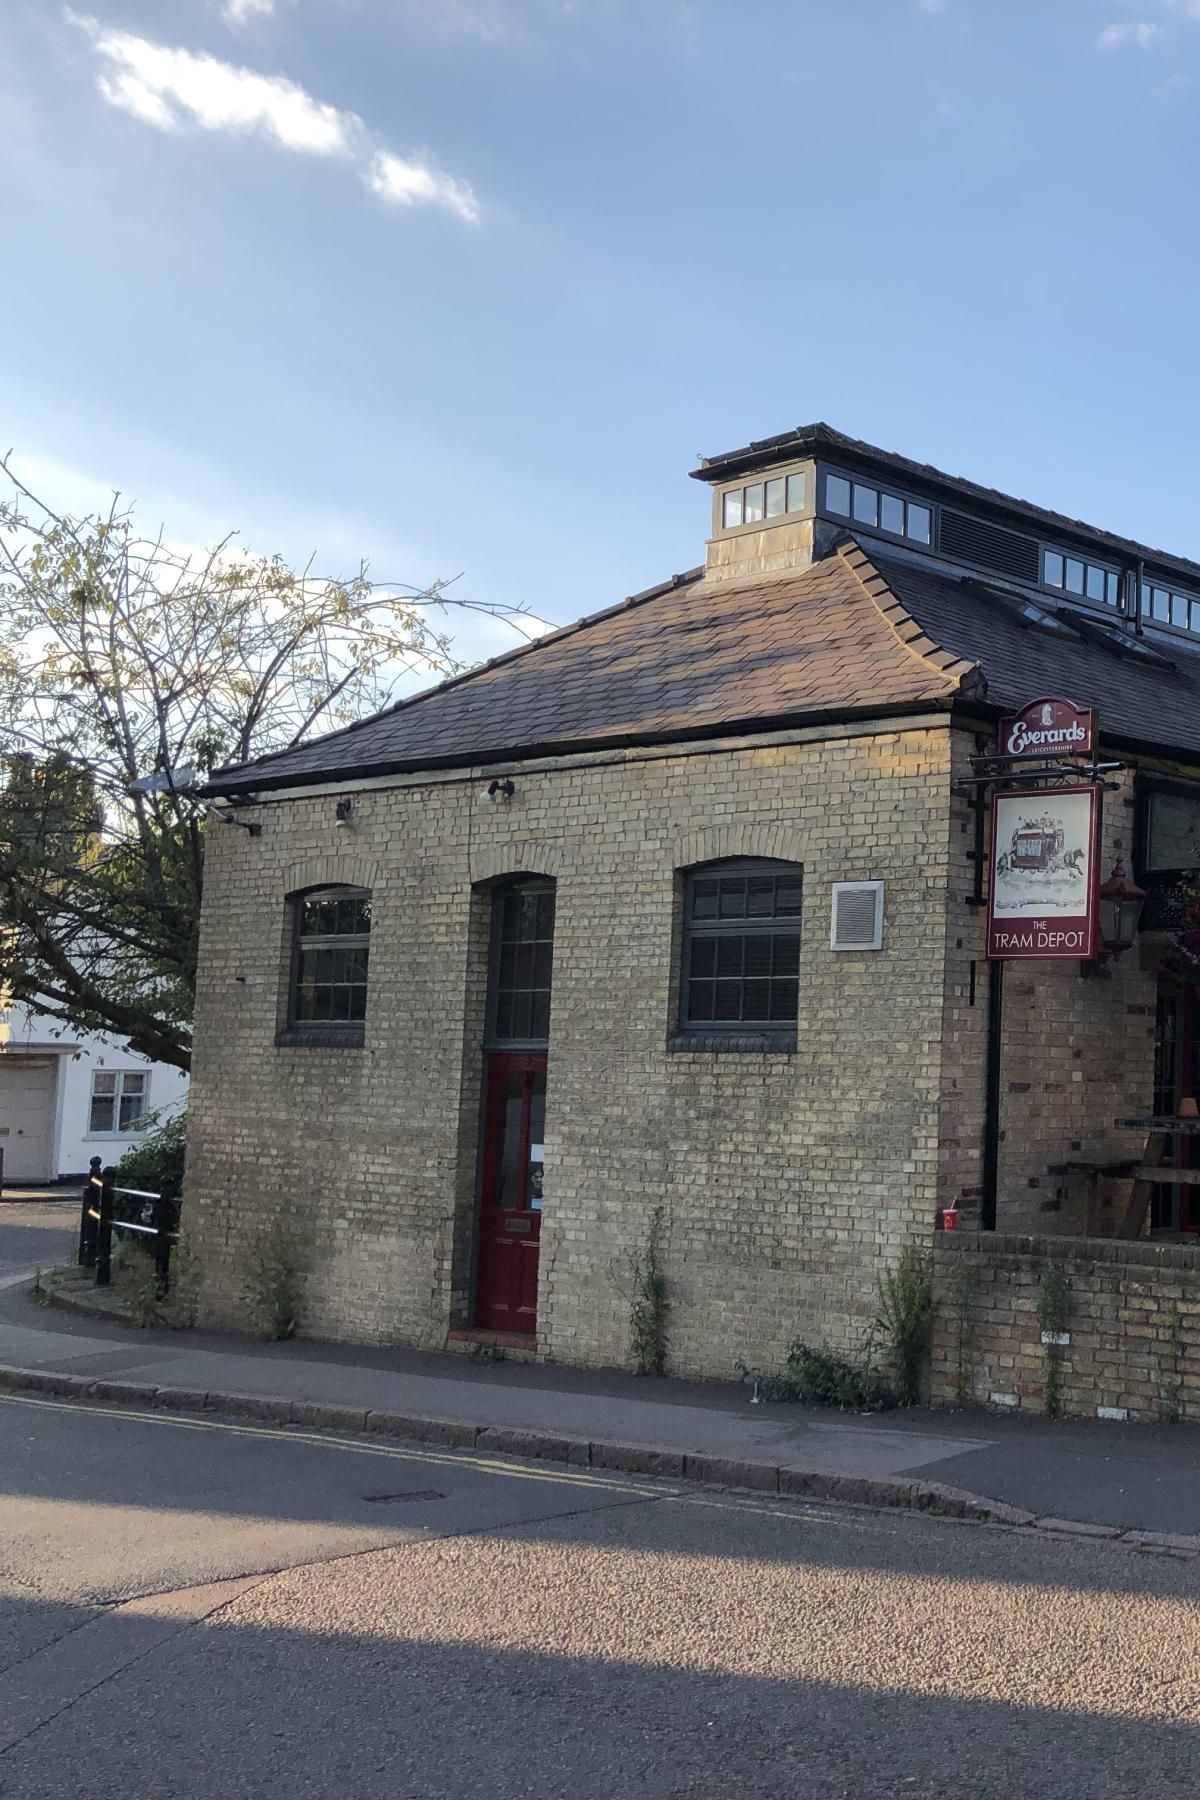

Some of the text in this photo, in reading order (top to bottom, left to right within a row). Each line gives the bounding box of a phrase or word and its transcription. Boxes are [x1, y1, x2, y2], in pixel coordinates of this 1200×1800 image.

[1007, 720, 1086, 754] Everards
[1033, 920, 1047, 930] THE
[994, 931, 1085, 948] TRAM DEPOT
